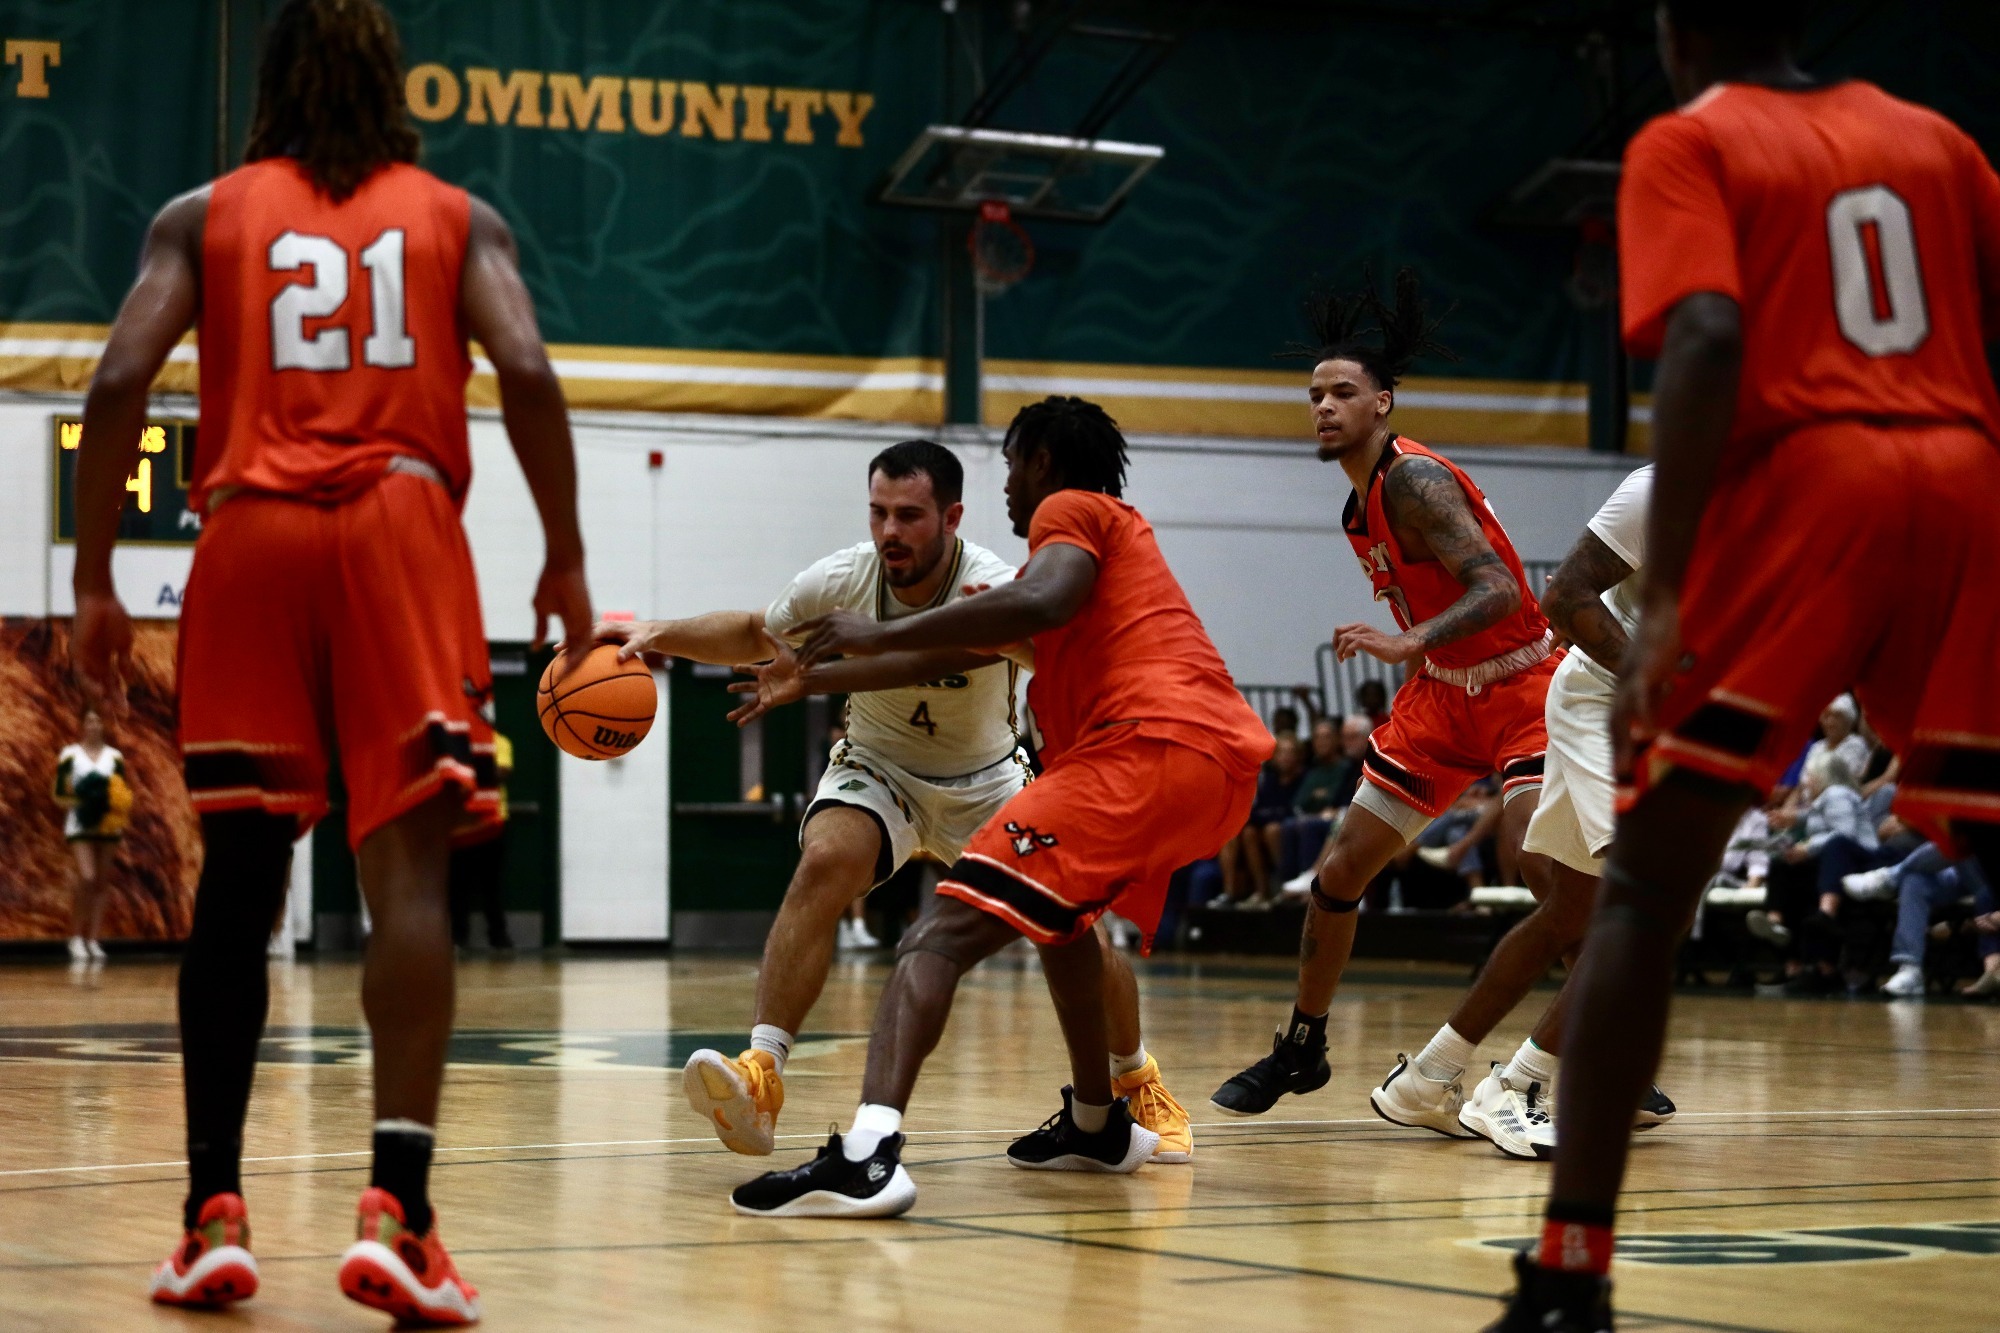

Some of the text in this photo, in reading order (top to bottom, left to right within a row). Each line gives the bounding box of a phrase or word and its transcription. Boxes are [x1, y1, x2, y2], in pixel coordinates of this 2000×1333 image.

[404, 63, 875, 147] OMMUNITY
[268, 229, 415, 371] 21
[1826, 183, 1931, 358] 0
[910, 701, 937, 736] 4
